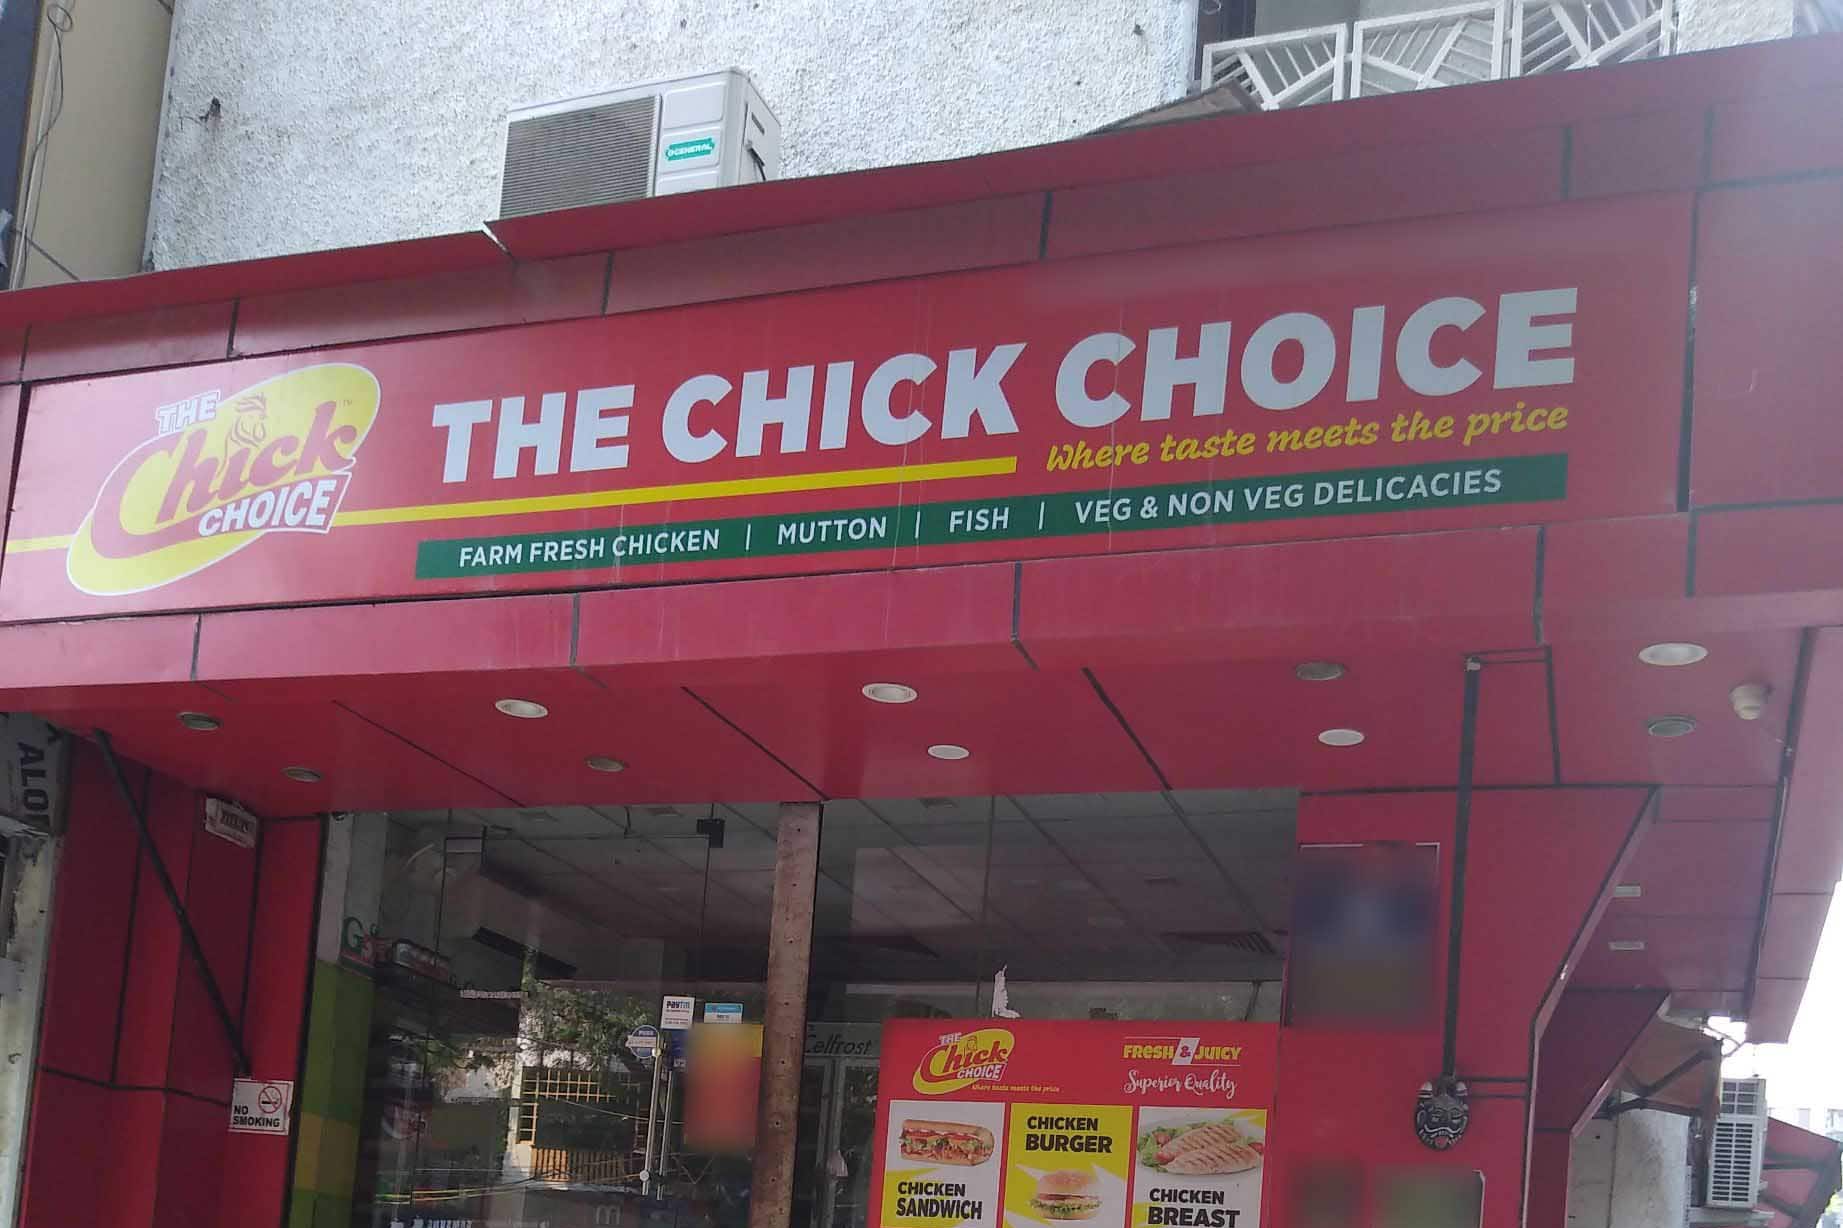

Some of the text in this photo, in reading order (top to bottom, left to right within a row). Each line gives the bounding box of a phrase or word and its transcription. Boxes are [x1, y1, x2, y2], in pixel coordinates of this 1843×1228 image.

[432, 288, 1578, 483] THE CHICK CHOICE
[157, 391, 220, 435] THE
[1160, 428, 1254, 463] taste
[1267, 417, 1380, 453] meets
[1391, 412, 1454, 443] the
[1463, 401, 1568, 446] price
[90, 400, 358, 559] Chick
[198, 479, 337, 537] CHOICE
[1075, 468, 1503, 525] VEG & NON VEG DELICACIES
[777, 515, 887, 546] MUTTON
[948, 506, 1010, 532] FISH
[458, 528, 720, 568] FARM FRESH CHICKEN
[939, 1032, 962, 1045] THE
[920, 1041, 1008, 1083] Chick
[1180, 1046, 1191, 1058] &
[1194, 1046, 1242, 1060] JUICY
[957, 1064, 1002, 1079] CHOICE
[1123, 1069, 1237, 1100] Superior Quality
[233, 1116, 280, 1127] SMOKING
[234, 1105, 249, 1115] NO
[1027, 1116, 1099, 1131] CHICKEN
[1025, 1133, 1113, 1153] BURGER
[897, 1181, 966, 1197] CHICKEN
[1149, 1188, 1225, 1205] CHICKEN
[896, 1197, 983, 1220] SANDWICH
[1148, 1206, 1241, 1228] BREAST
